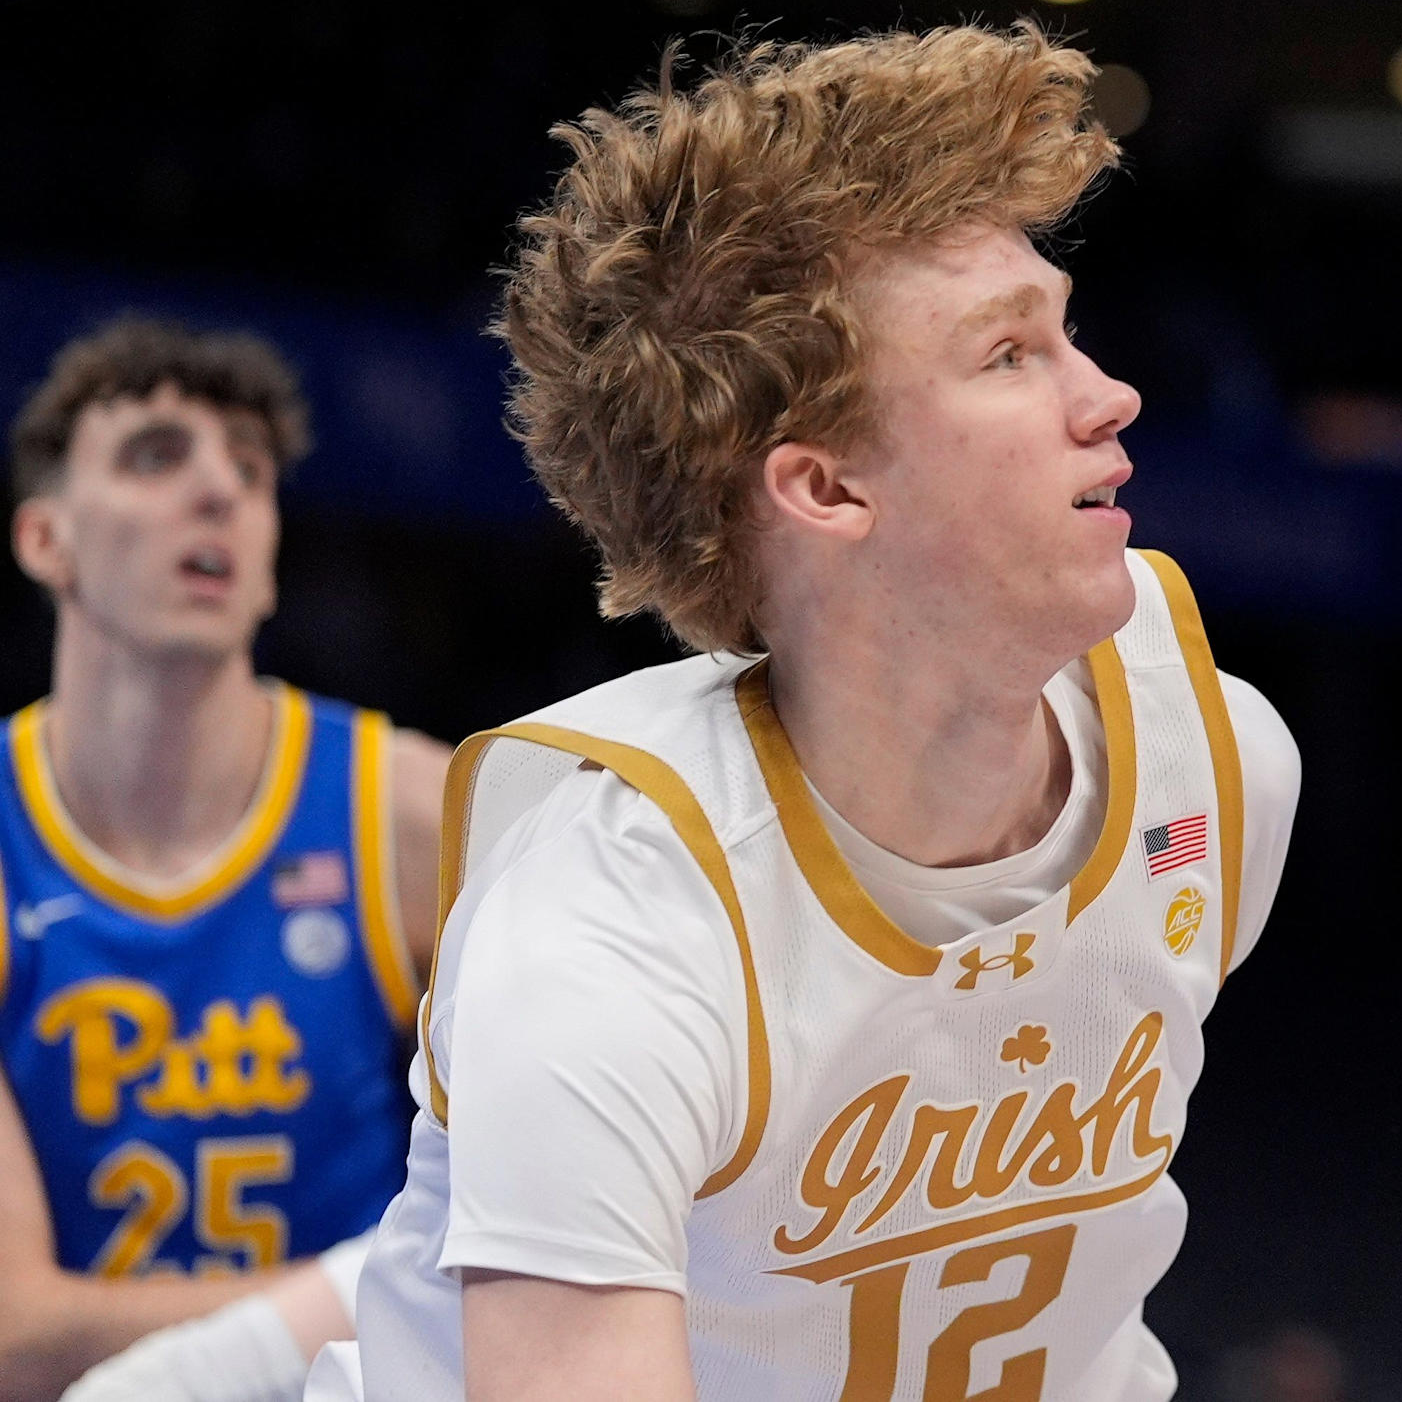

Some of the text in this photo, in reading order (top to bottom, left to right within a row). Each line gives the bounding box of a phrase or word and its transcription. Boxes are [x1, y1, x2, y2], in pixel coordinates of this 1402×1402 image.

[1168, 902, 1204, 931] ACC
[35, 975, 311, 1125] Pitt
[89, 1133, 295, 1283] 25
[772, 1010, 1174, 1256] Irish
[838, 1223, 1079, 1402] 12
